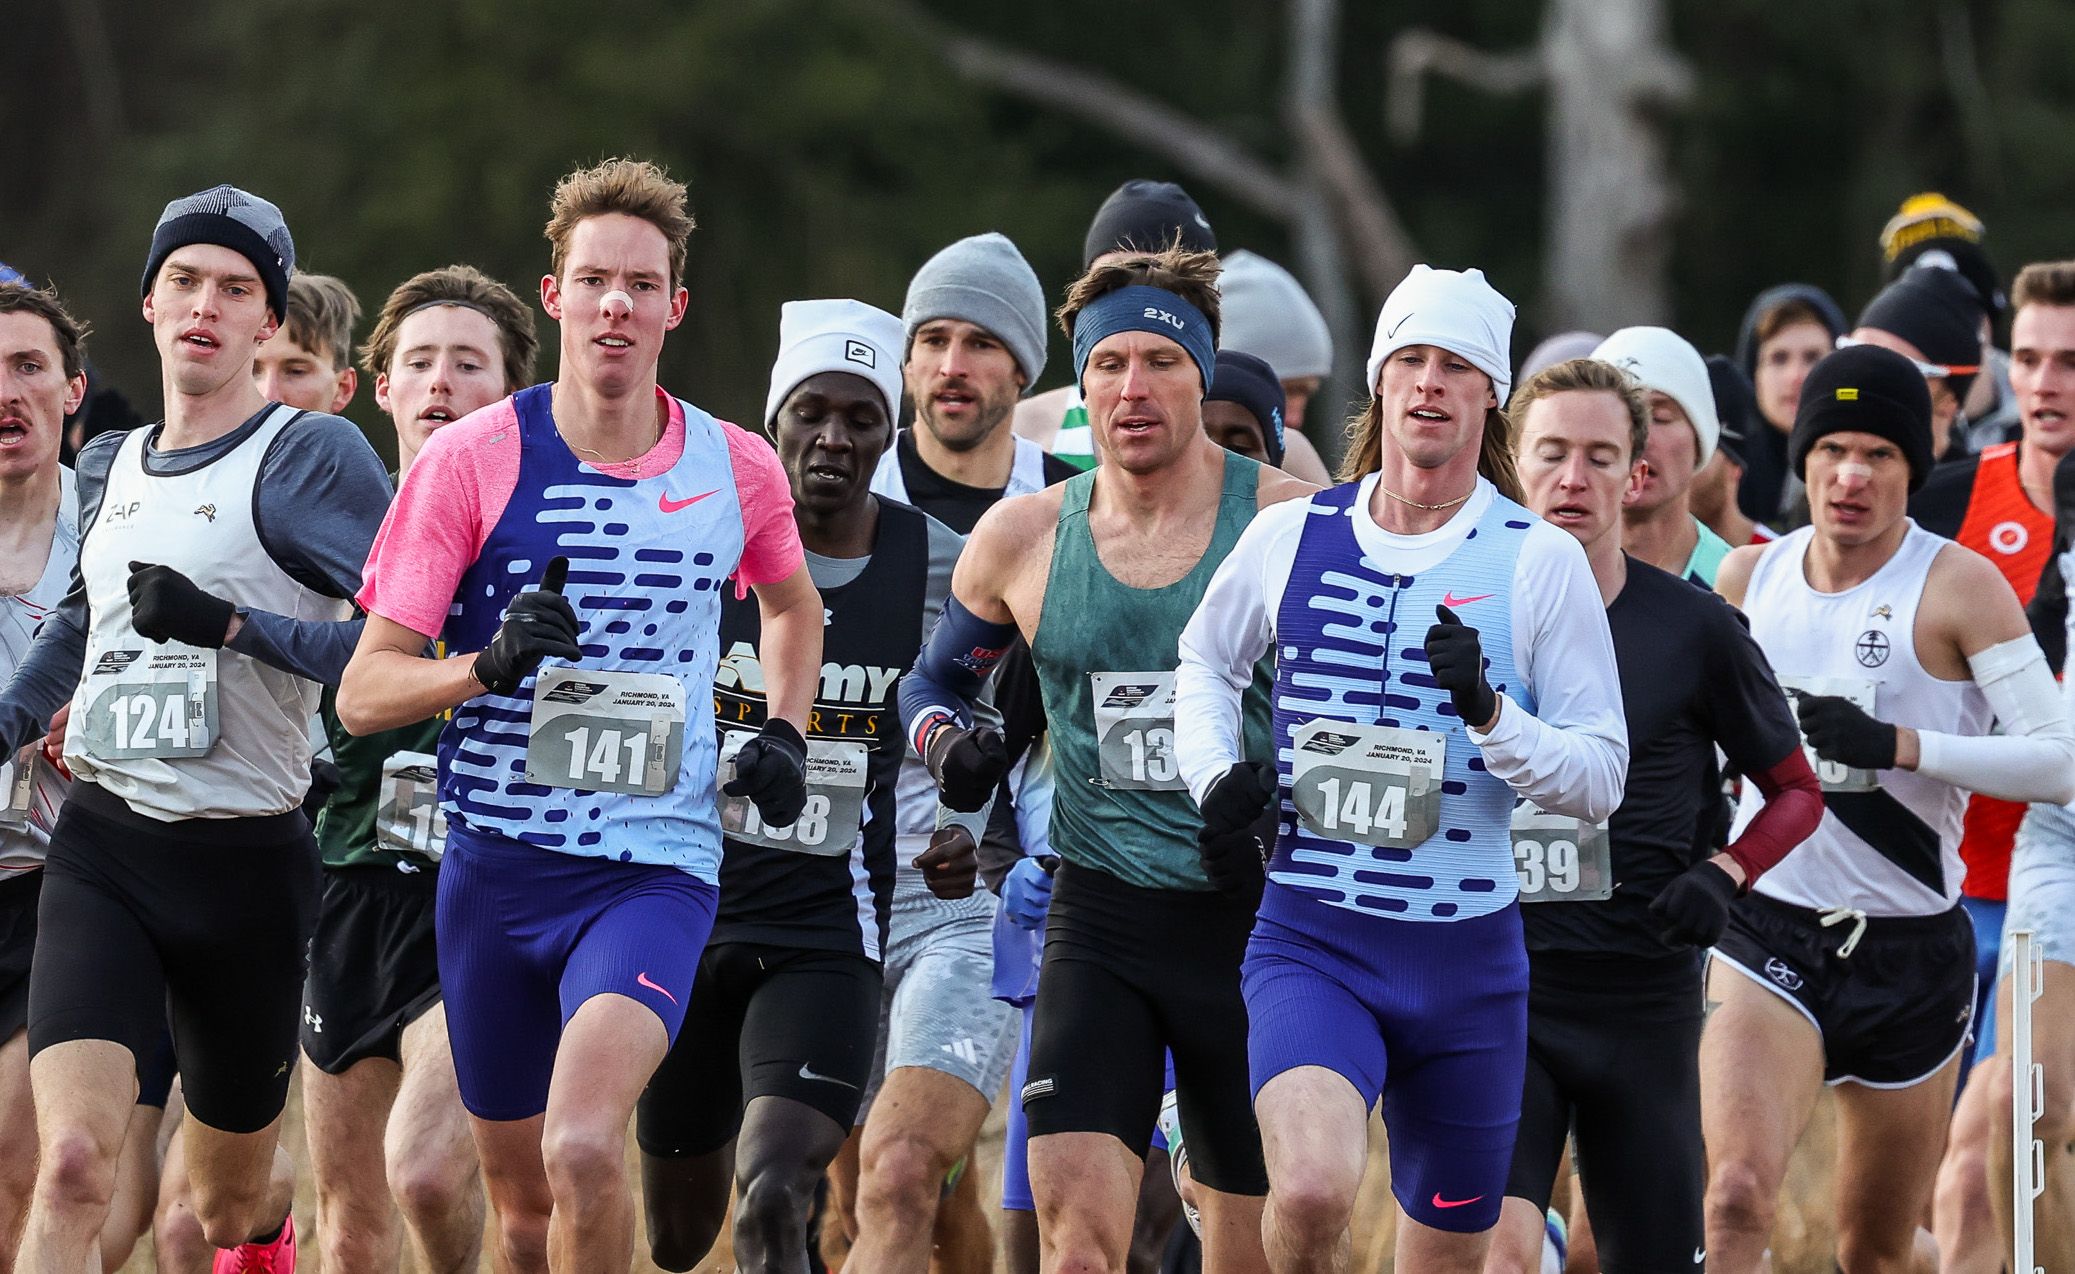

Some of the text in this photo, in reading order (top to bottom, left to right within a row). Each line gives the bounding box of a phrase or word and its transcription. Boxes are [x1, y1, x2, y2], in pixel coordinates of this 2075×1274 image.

[1143, 307, 1185, 330] 2XU
[620, 691, 659, 700] RICHMOND,
[714, 695, 878, 735] SPRTS
[109, 694, 190, 749] 124
[564, 726, 648, 786] 141
[1122, 728, 1179, 782] 13
[1366, 751, 1399, 760] JANUARY
[1401, 755, 1412, 763] 20,
[1373, 744, 1414, 756] RICHMOND,
[1317, 777, 1408, 839] 144
[1514, 840, 1580, 894] 39
